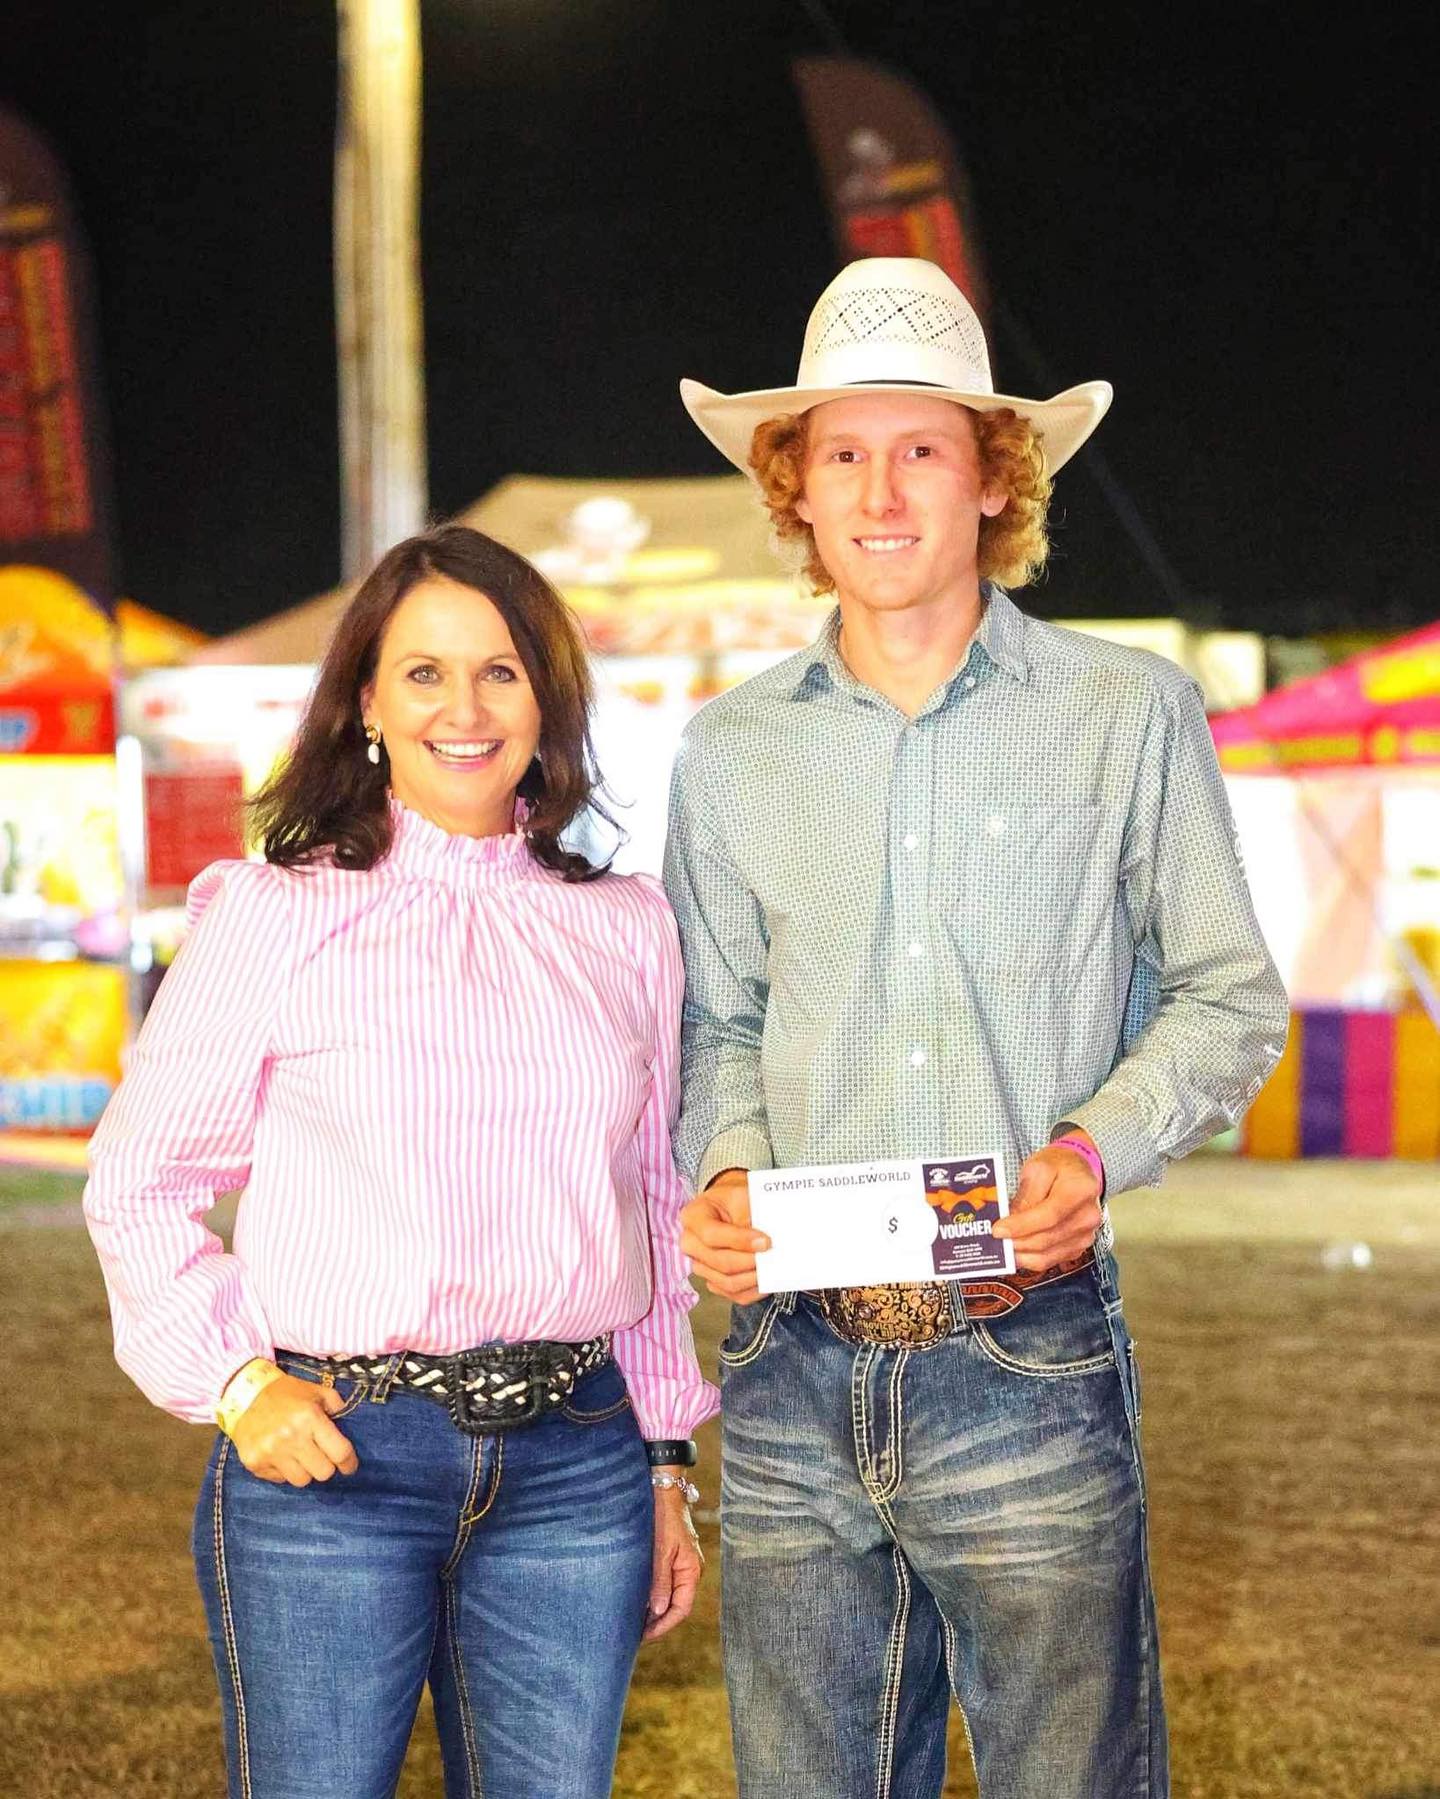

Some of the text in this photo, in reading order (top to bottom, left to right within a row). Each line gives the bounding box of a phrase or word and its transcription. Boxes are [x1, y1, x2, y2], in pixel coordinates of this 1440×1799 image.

[763, 1172, 911, 1192] GYMPIE SADDLEWORLD
[888, 1217, 899, 1234] $
[939, 1219, 992, 1240] VOUCHER
